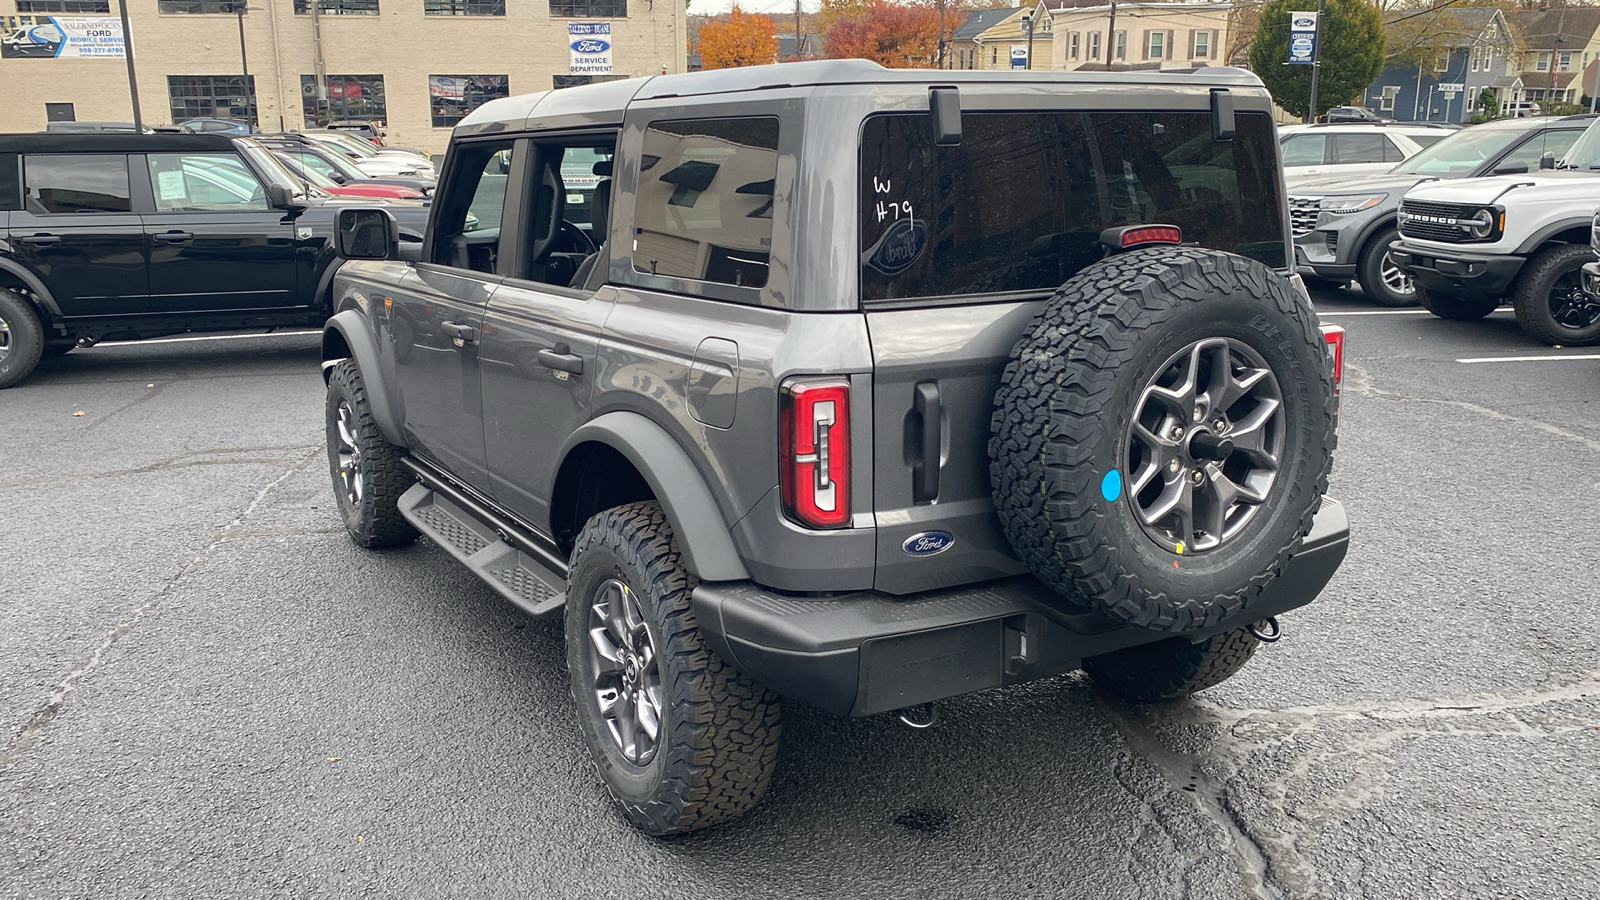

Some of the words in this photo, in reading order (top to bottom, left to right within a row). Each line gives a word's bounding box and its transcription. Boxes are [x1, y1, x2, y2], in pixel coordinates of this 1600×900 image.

[577, 40, 604, 52] Ford
[873, 176, 891, 194] W
[1407, 214, 1457, 224] BRONCO
[1248, 314, 1315, 505] BFGoodrich
[915, 536, 943, 552] Ford
